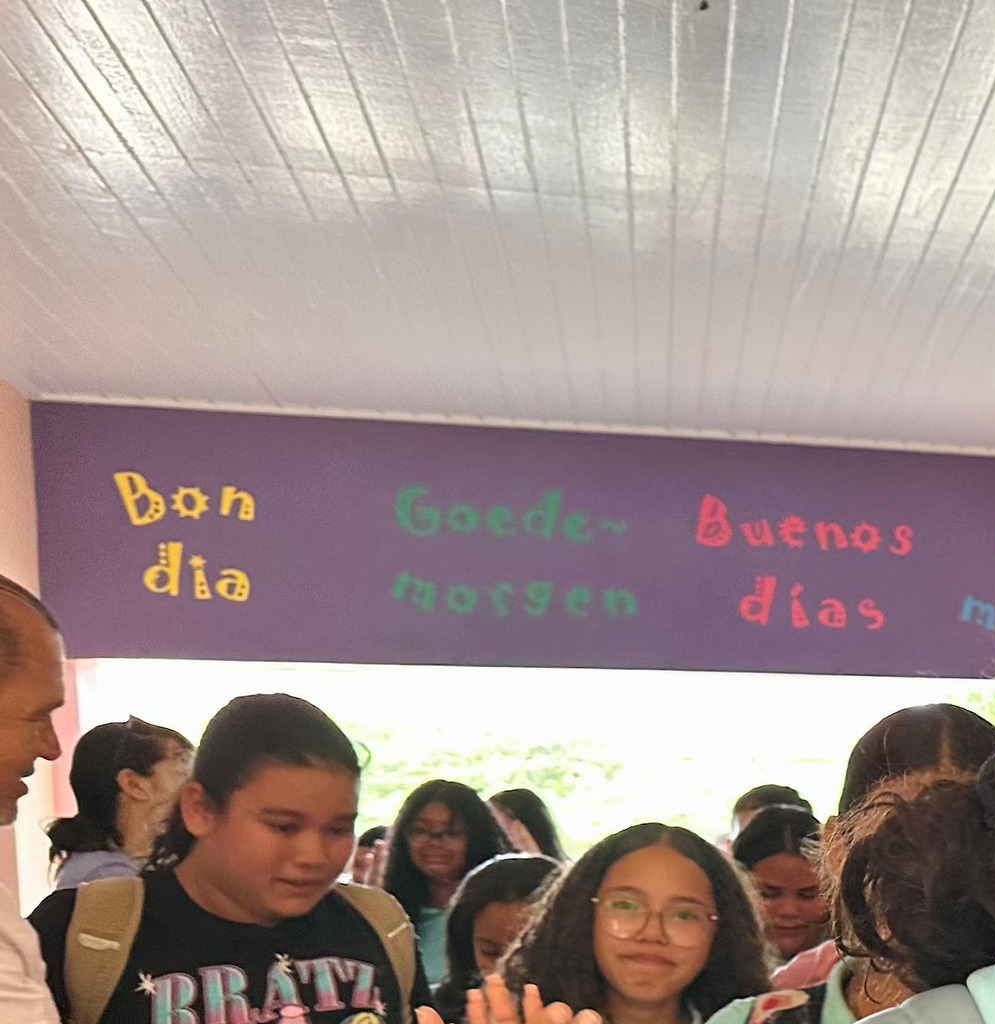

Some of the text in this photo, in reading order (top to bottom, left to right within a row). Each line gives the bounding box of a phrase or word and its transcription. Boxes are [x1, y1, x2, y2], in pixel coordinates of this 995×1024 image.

[113, 471, 256, 526] Bon
[695, 493, 915, 557] Buenos
[142, 541, 251, 602] dia
[391, 571, 639, 617] morgen
[738, 573, 887, 631] días
